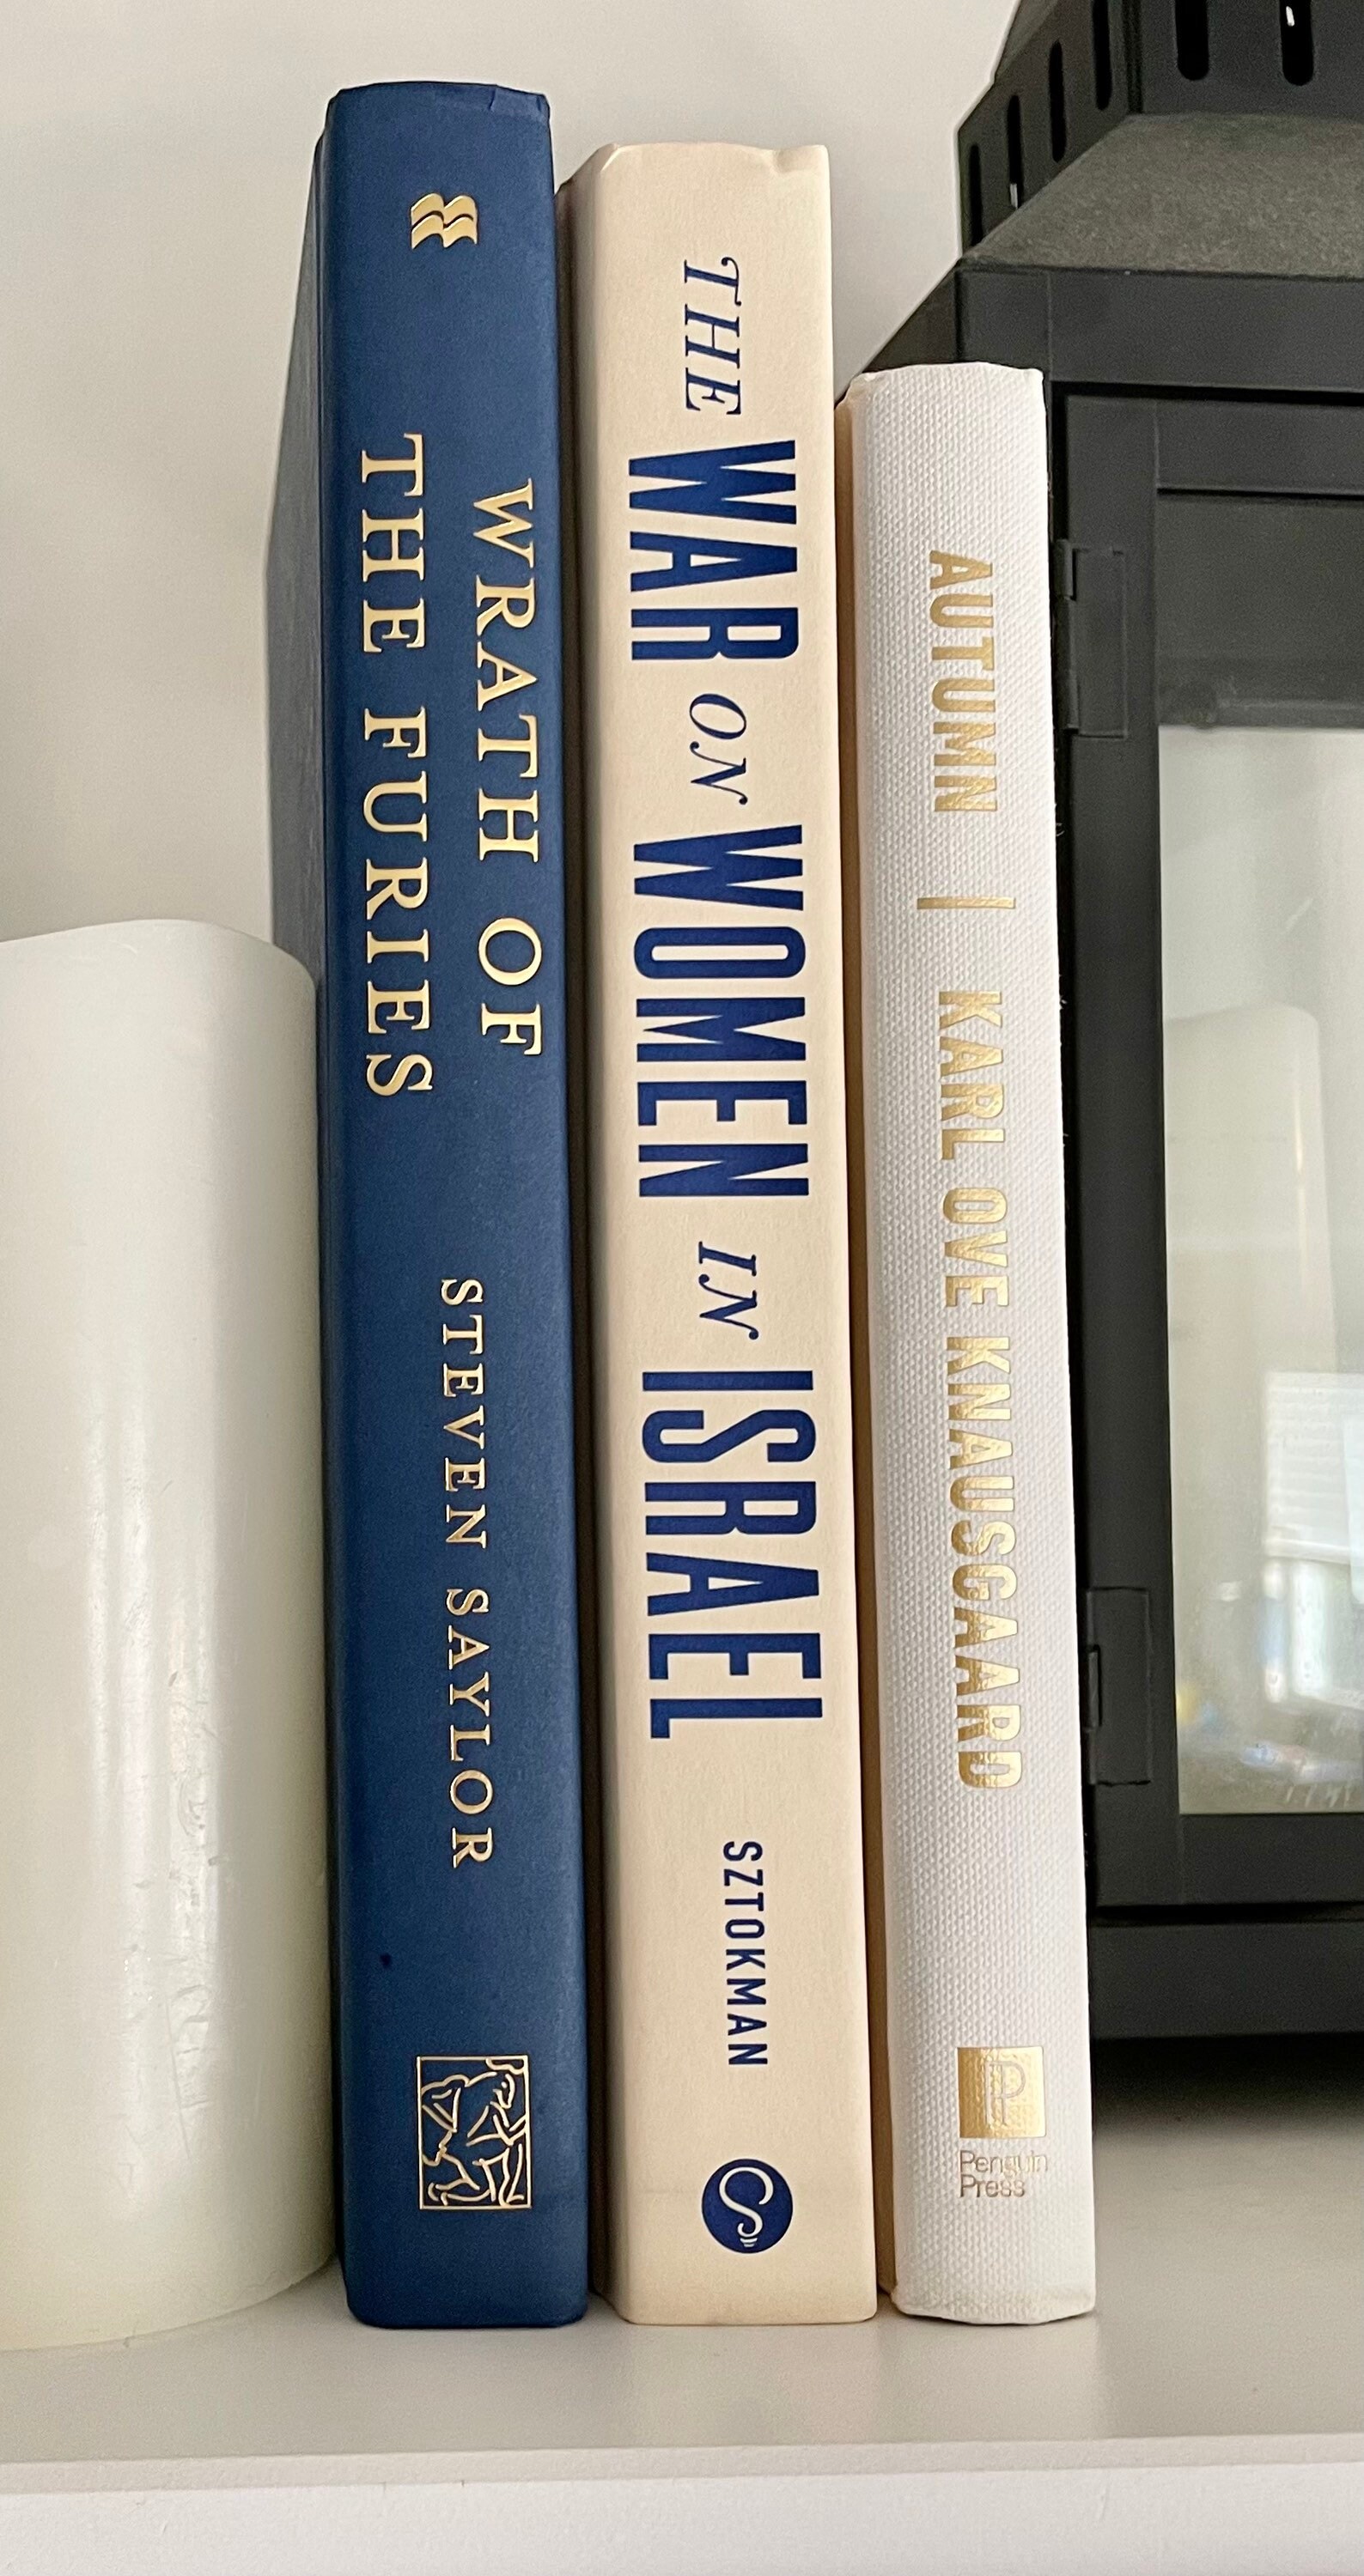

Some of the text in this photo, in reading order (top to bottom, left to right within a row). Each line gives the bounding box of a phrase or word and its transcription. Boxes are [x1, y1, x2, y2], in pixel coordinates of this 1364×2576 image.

[361, 433, 433, 1097] THE FURIES
[473, 478, 543, 1055] WRATH OF
[929, 550, 998, 812] AUTUMN
[628, 257, 824, 1740] THE WAR ON WOMEN IN ISRAEL
[440, 1279, 493, 1869] STEVEN SAYLOR
[938, 990, 1024, 1789] KARL OVE KNAUSGAARD
[723, 1840, 769, 2068] SZTOKMAN
[959, 2150, 1048, 2175] Penguin
[959, 2175, 1026, 2198] Press
